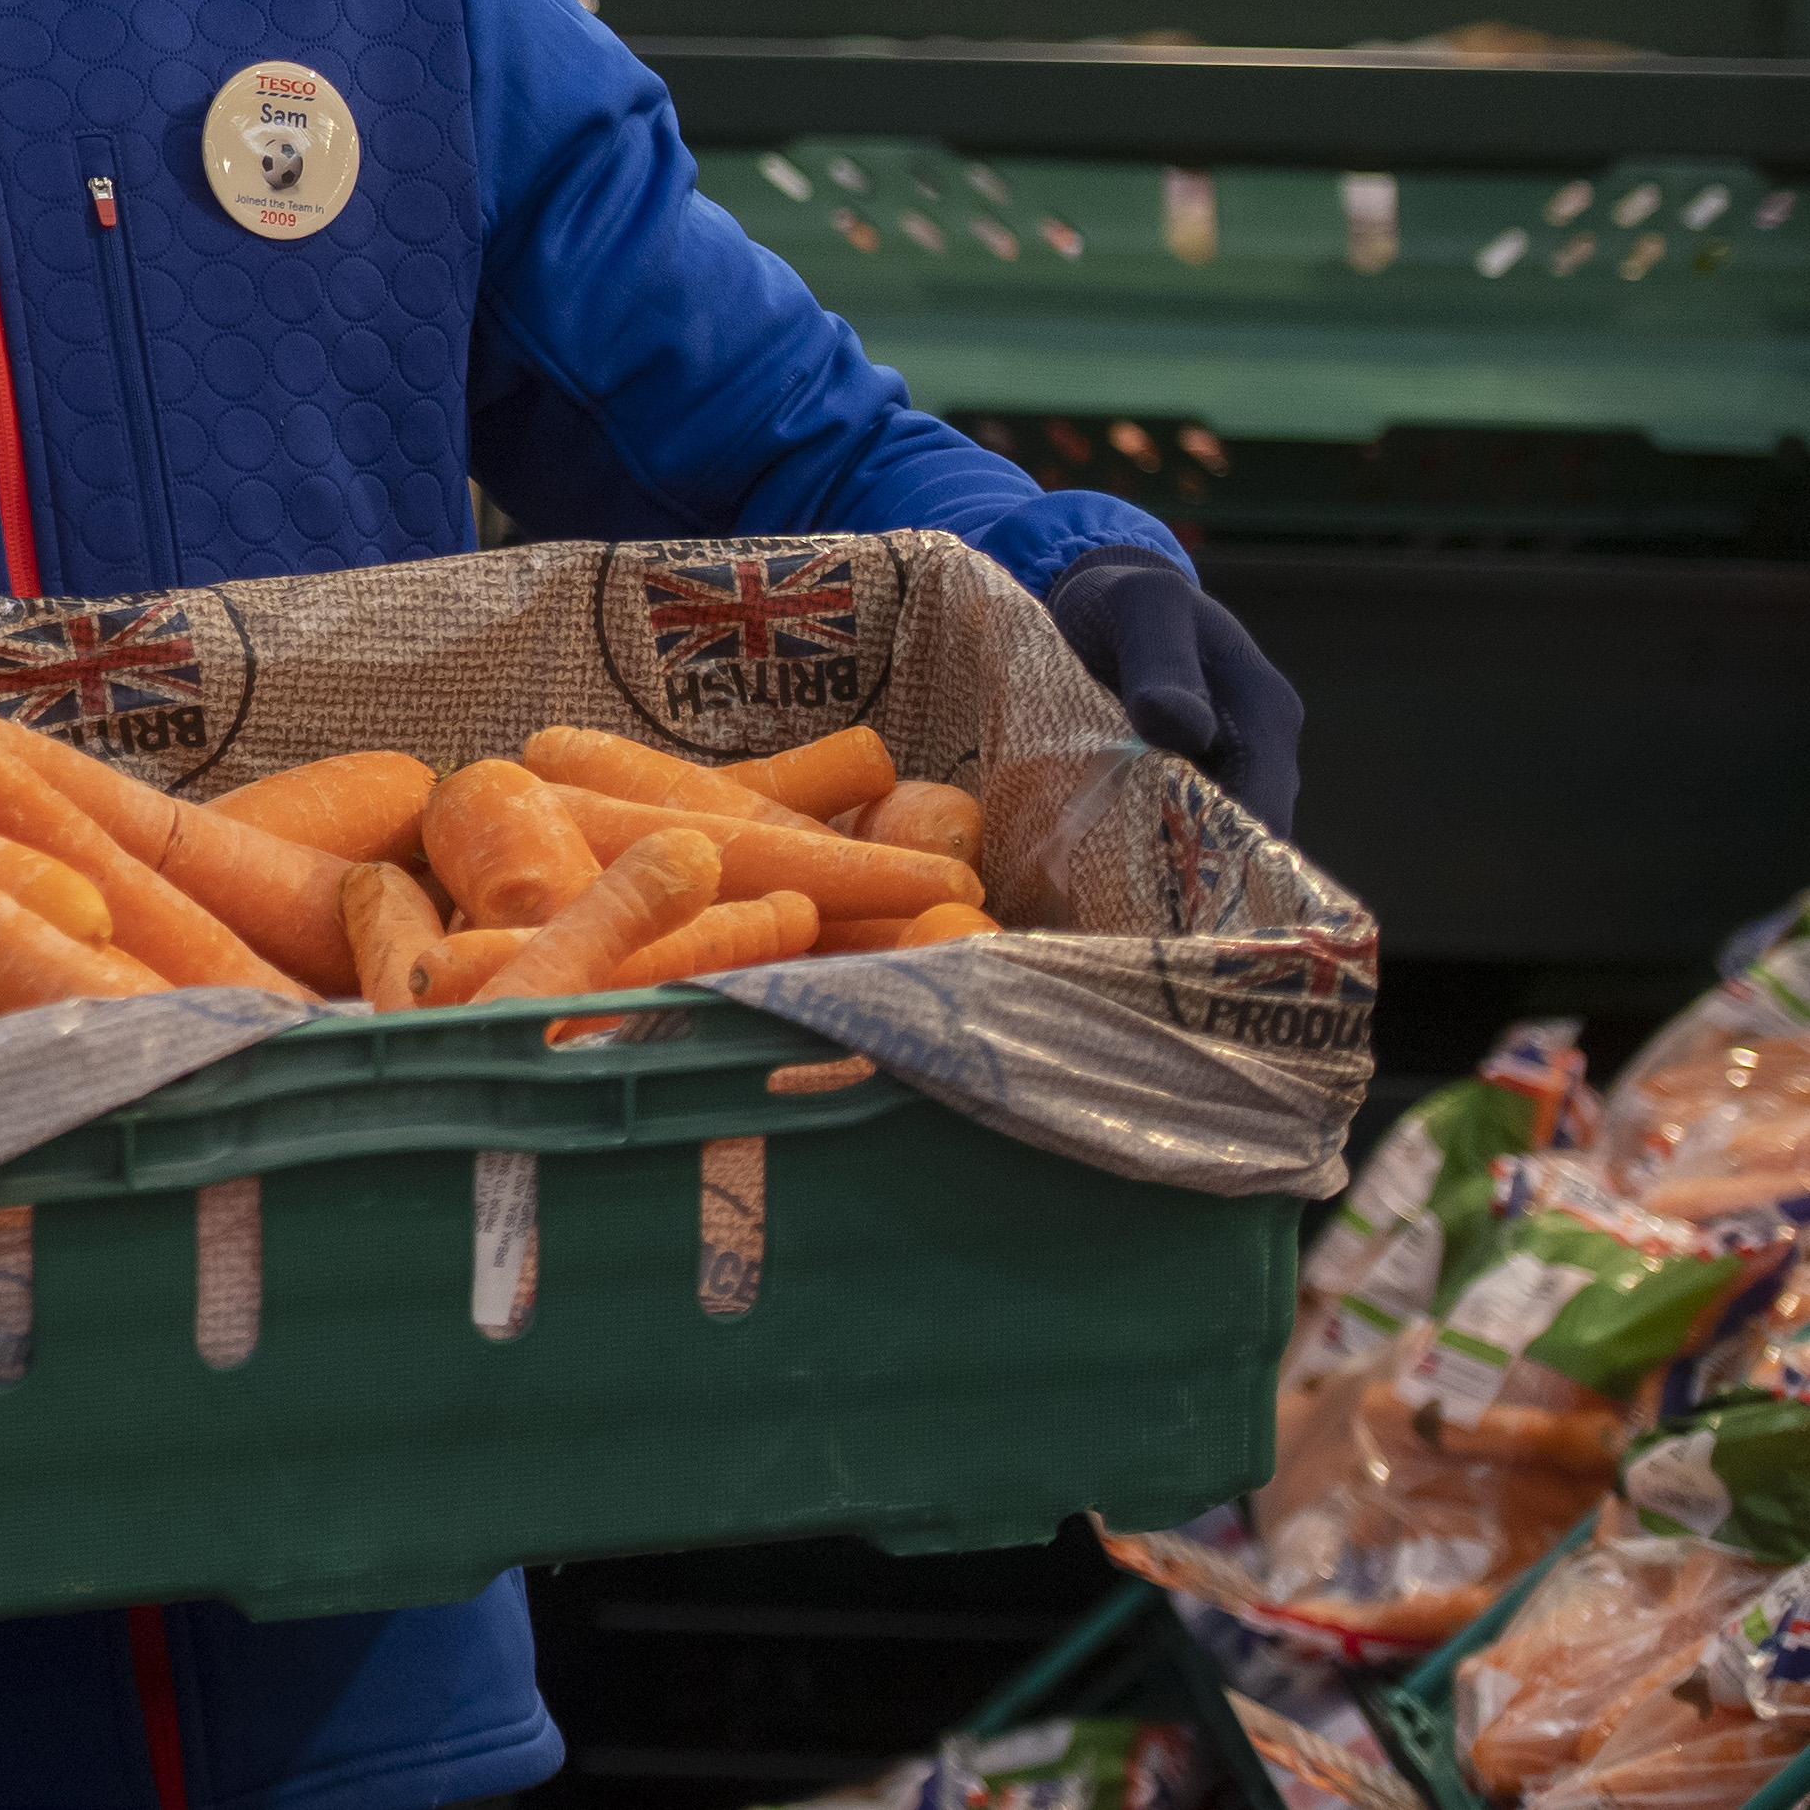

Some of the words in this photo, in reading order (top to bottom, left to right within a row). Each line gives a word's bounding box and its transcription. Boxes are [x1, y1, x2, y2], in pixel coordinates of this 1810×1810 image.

[256, 75, 316, 96] TESCO
[260, 103, 307, 129] Sam
[235, 194, 267, 207] Joined
[269, 199, 285, 209] the
[288, 200, 313, 212] Team
[260, 210, 297, 227] 2009
[664, 655, 859, 721] BRITISH
[1202, 997, 1371, 1050] PRODU
